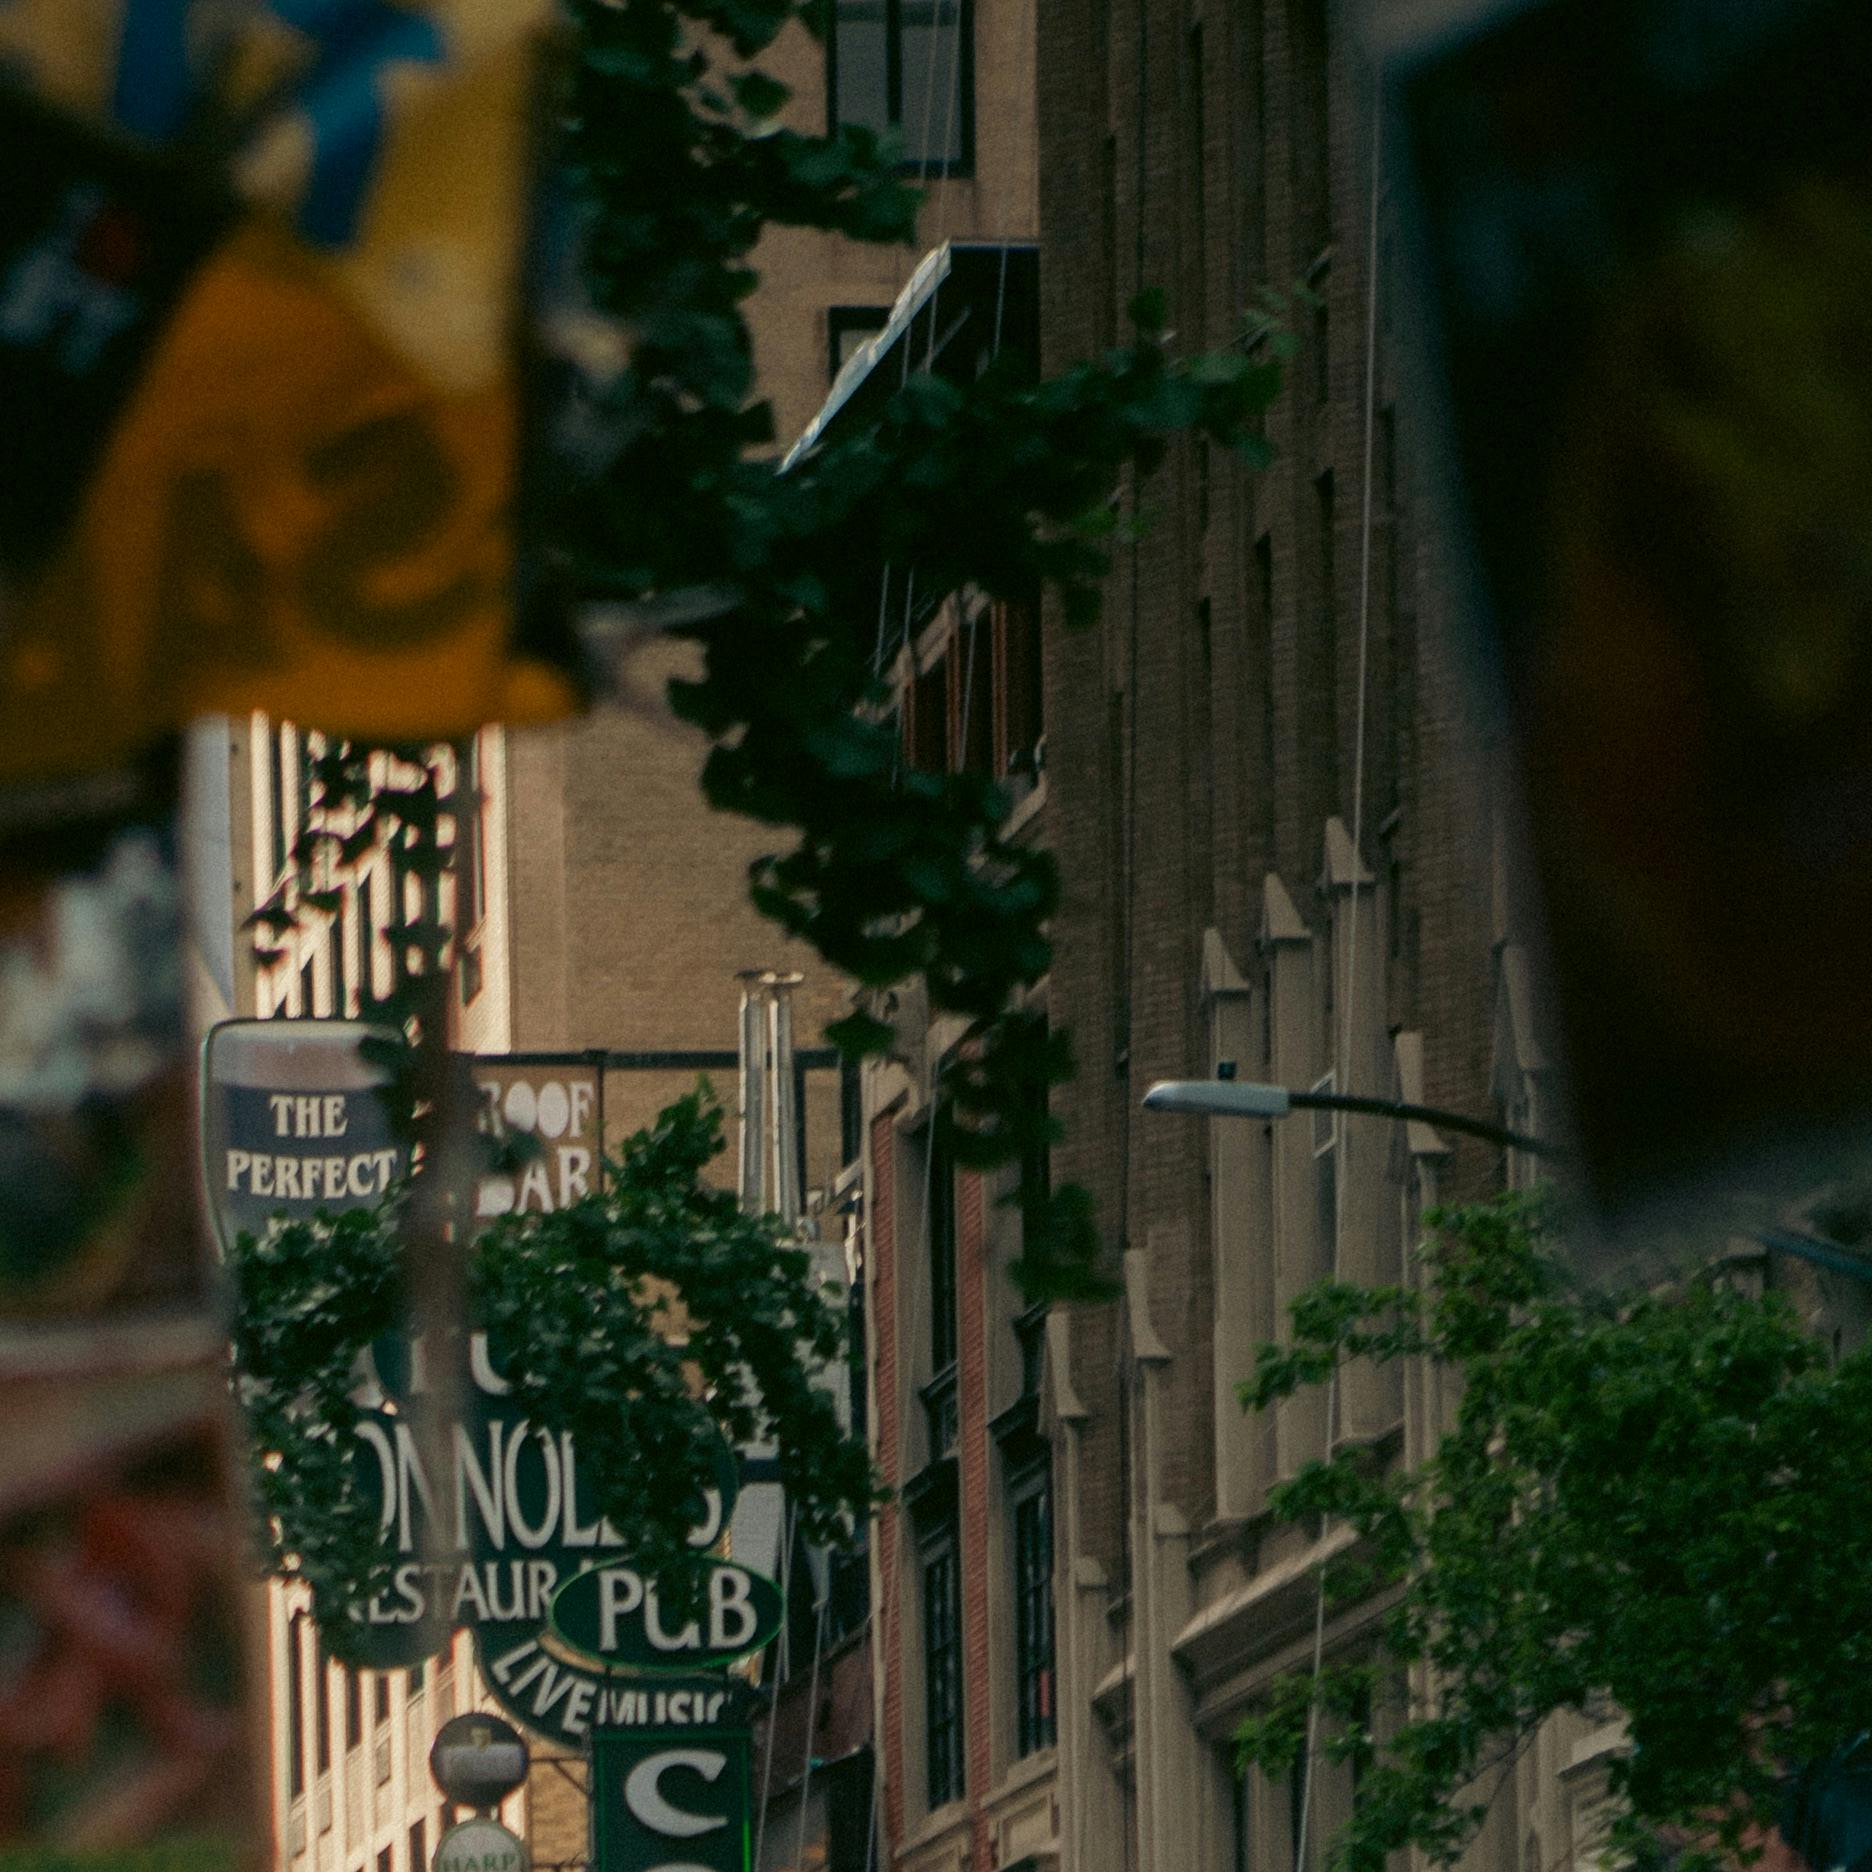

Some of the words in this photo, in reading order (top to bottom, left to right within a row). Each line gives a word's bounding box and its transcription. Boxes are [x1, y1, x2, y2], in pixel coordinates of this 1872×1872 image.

[270, 1094, 348, 1137] THE
[227, 1149, 397, 1200] PERFECT
[491, 1641, 598, 1735] LIVE
